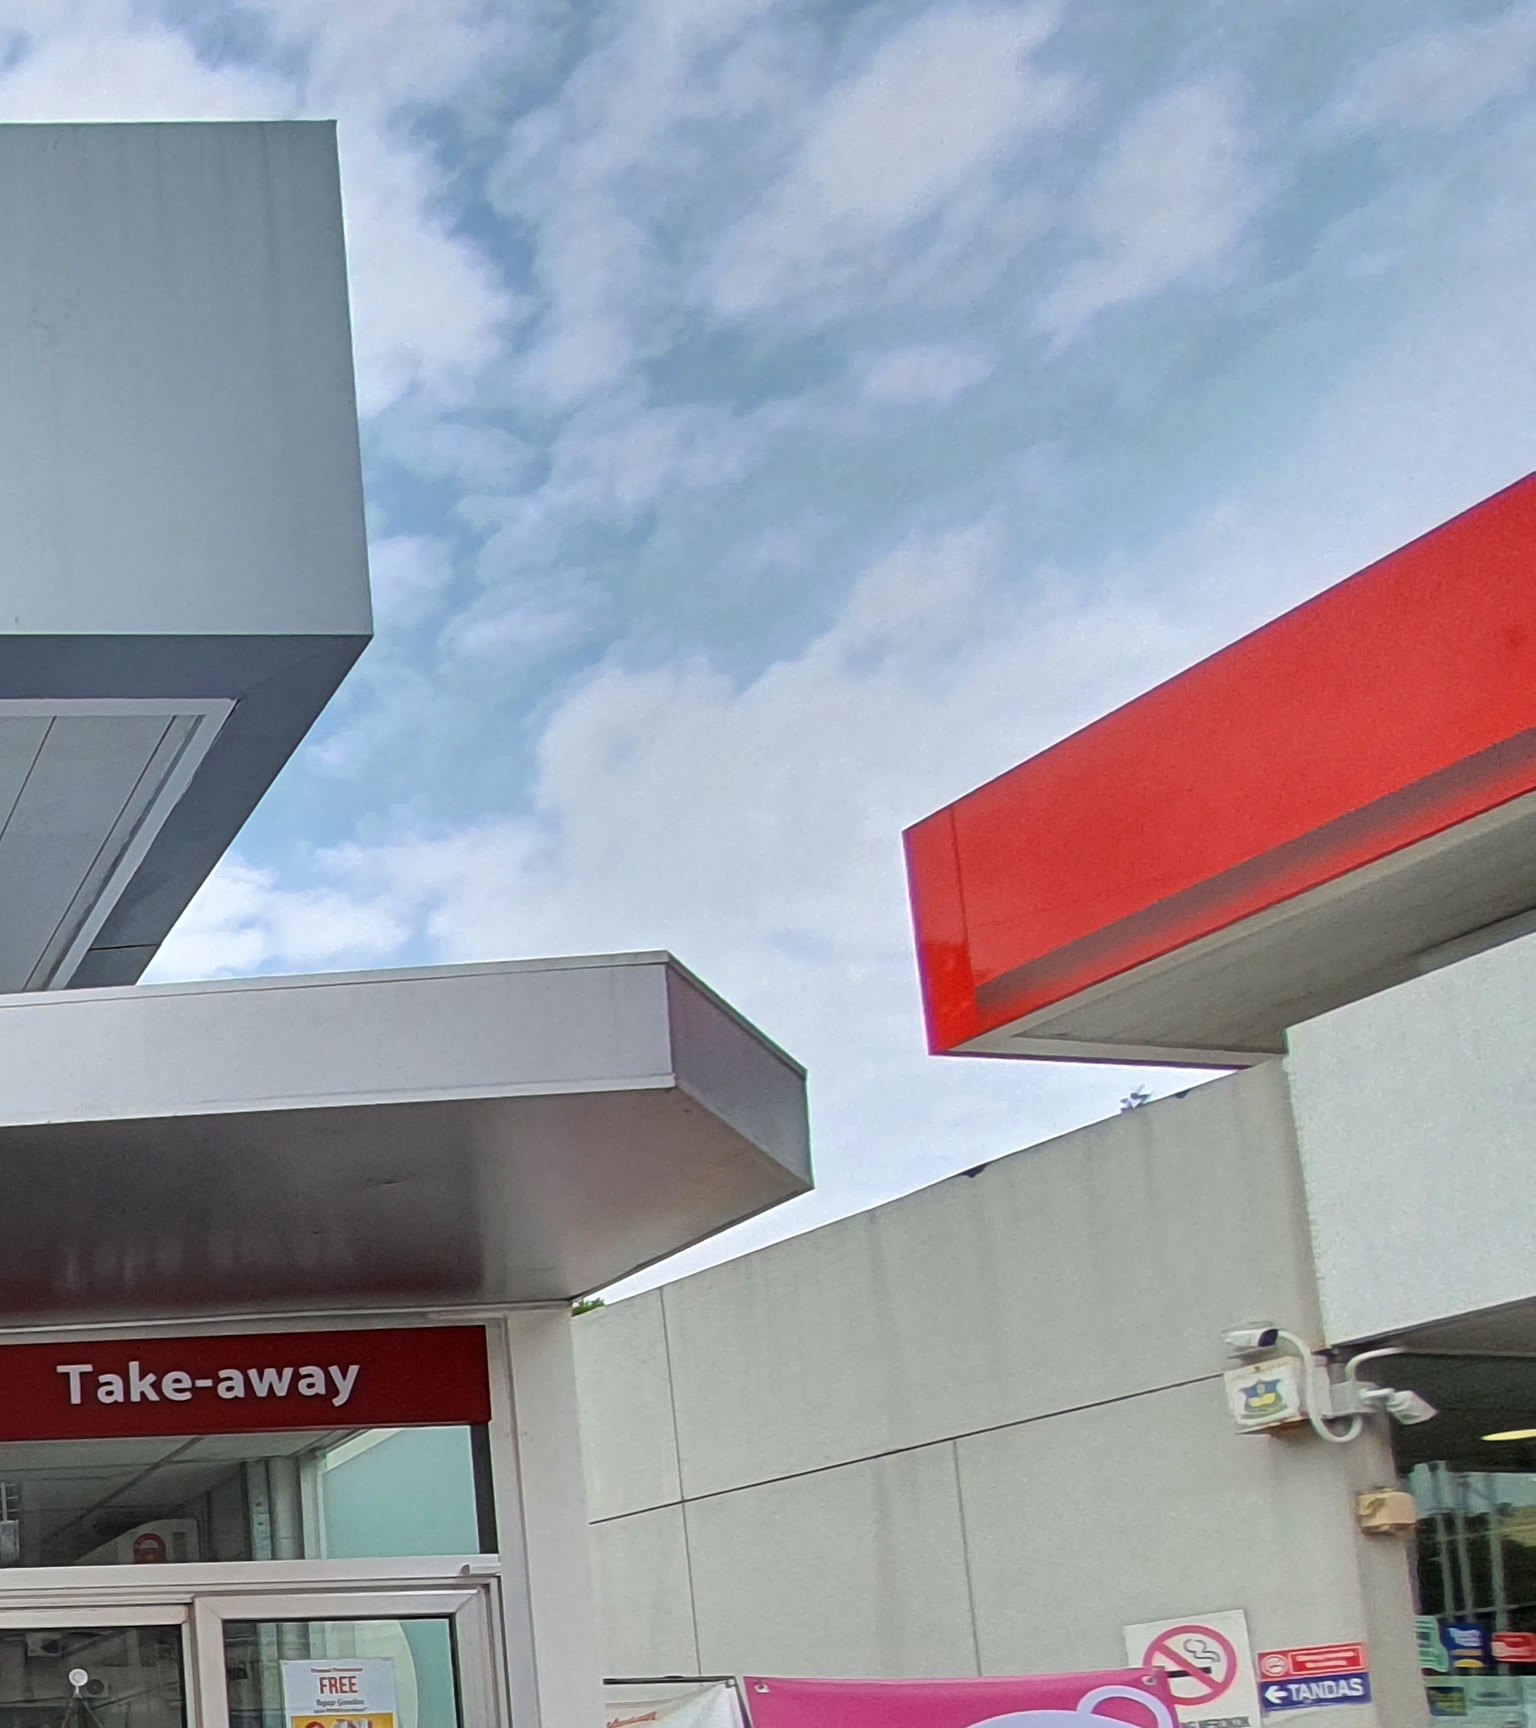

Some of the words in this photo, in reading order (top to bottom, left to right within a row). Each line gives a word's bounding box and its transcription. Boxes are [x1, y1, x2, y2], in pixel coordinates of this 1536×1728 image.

[56, 1361, 360, 1407] Take-away
[319, 1676, 358, 1694] FREE
[1287, 1678, 1364, 1701] TANDAS
